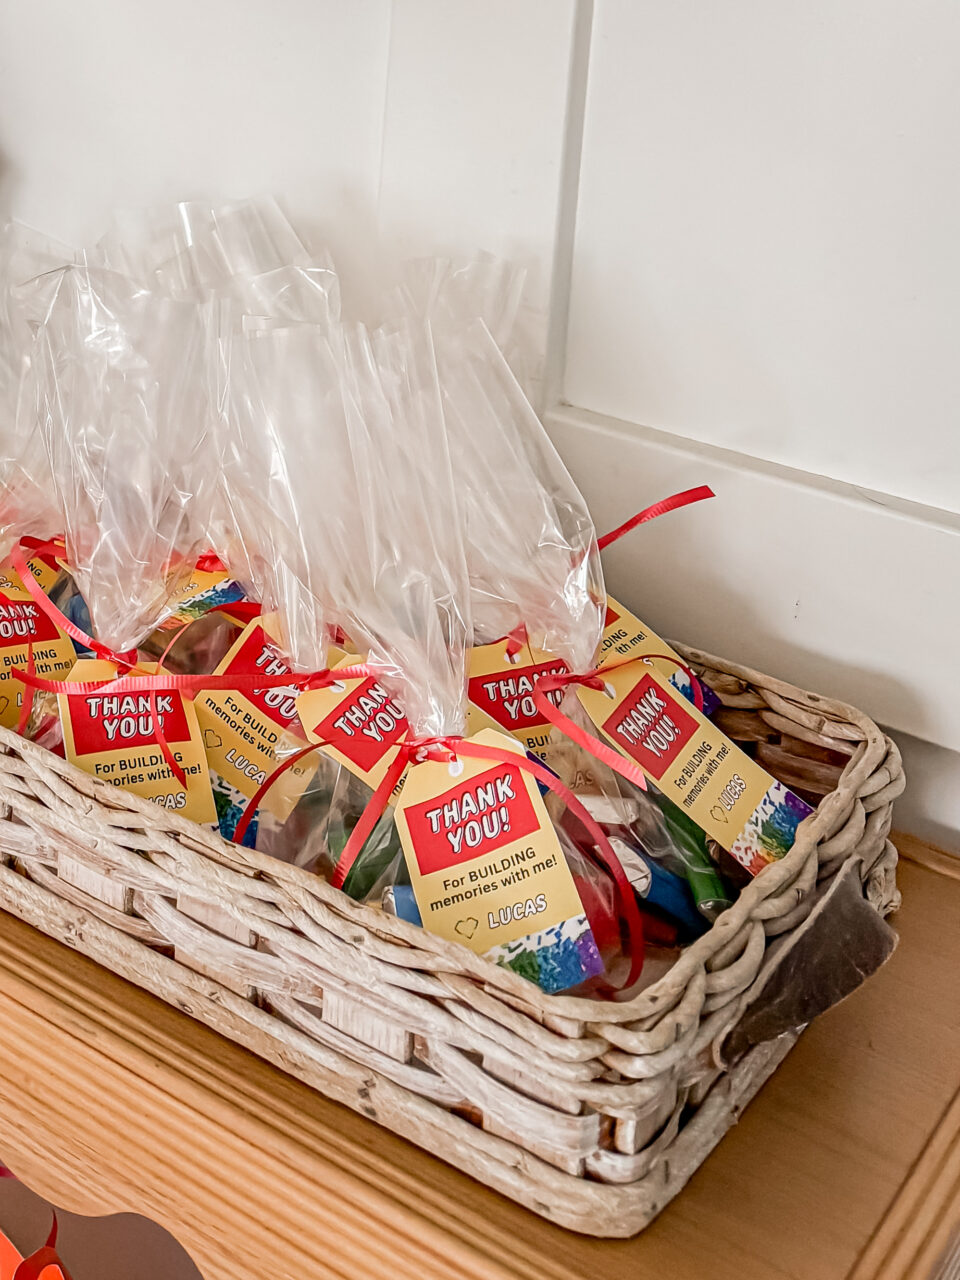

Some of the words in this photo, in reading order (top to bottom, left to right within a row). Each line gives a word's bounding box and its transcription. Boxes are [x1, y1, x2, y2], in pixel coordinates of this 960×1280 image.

[86, 695, 174, 719] THANK
[205, 697, 256, 745] memories
[224, 696, 244, 716] For
[243, 713, 278, 744] BUILD
[333, 682, 389, 736] THAN
[616, 686, 667, 745] THANK
[642, 714, 681, 758] YOU!
[95, 763, 116, 774] For
[119, 752, 183, 771] BUILDIG
[147, 769, 175, 780] with
[225, 748, 268, 786] LUCA
[674, 775, 688, 789] For
[682, 741, 712, 778] BUILDING
[683, 773, 710, 808] memories
[705, 758, 719, 776] with
[716, 742, 731, 761] me!
[425, 773, 516, 833] THANK
[718, 773, 746, 811] LUCAS
[446, 806, 511, 854] YOU!
[430, 881, 498, 911] memories
[501, 869, 530, 887] with
[533, 854, 558, 875] me!
[443, 876, 466, 891] For
[468, 847, 536, 882] BUILDING
[488, 894, 547, 929] LUCAS
